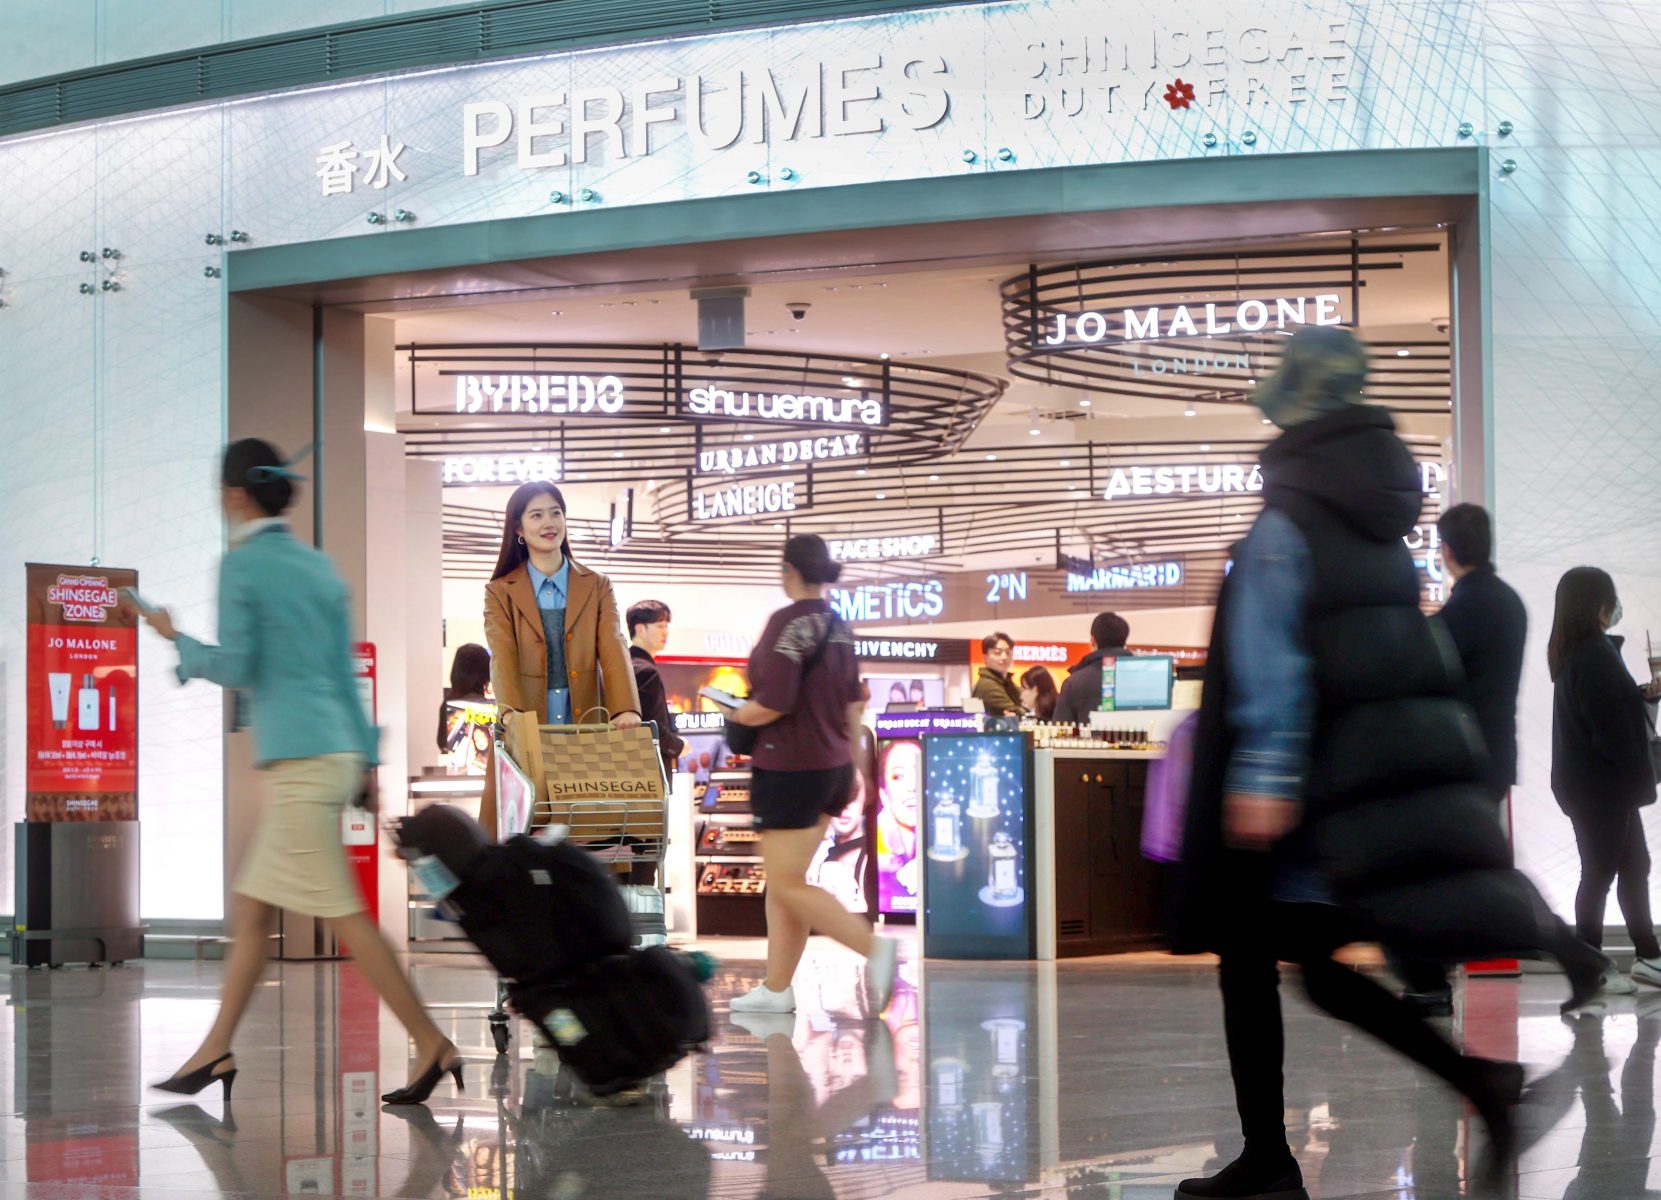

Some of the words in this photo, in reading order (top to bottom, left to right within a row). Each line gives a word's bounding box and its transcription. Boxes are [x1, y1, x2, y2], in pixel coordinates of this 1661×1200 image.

[1026, 24, 1346, 79] SHINSEGAE
[1023, 80, 1157, 120] DUTY
[1206, 72, 1348, 108] FREE
[463, 54, 950, 177] PERFUMES
[316, 136, 408, 197] 香水
[1046, 311, 1107, 345] JO
[1124, 294, 1342, 340] MALONE
[1133, 353, 1250, 376] LONDON
[456, 375, 624, 413] BYREDO
[689, 385, 749, 416] shu
[757, 393, 881, 425] uemura
[444, 456, 560, 482] FOREVER
[700, 442, 778, 474] URBAN
[782, 433, 860, 462] DECAY
[698, 481, 796, 519] LANEIGE
[1104, 464, 1264, 500] AESTURA
[829, 538, 881, 560] FACE
[882, 535, 936, 557] SHOP
[48, 587, 116, 604] SHINSEGAE
[47, 638, 64, 648] JO
[66, 639, 117, 650] MALONE
[553, 780, 656, 794] SHINSEGAE
